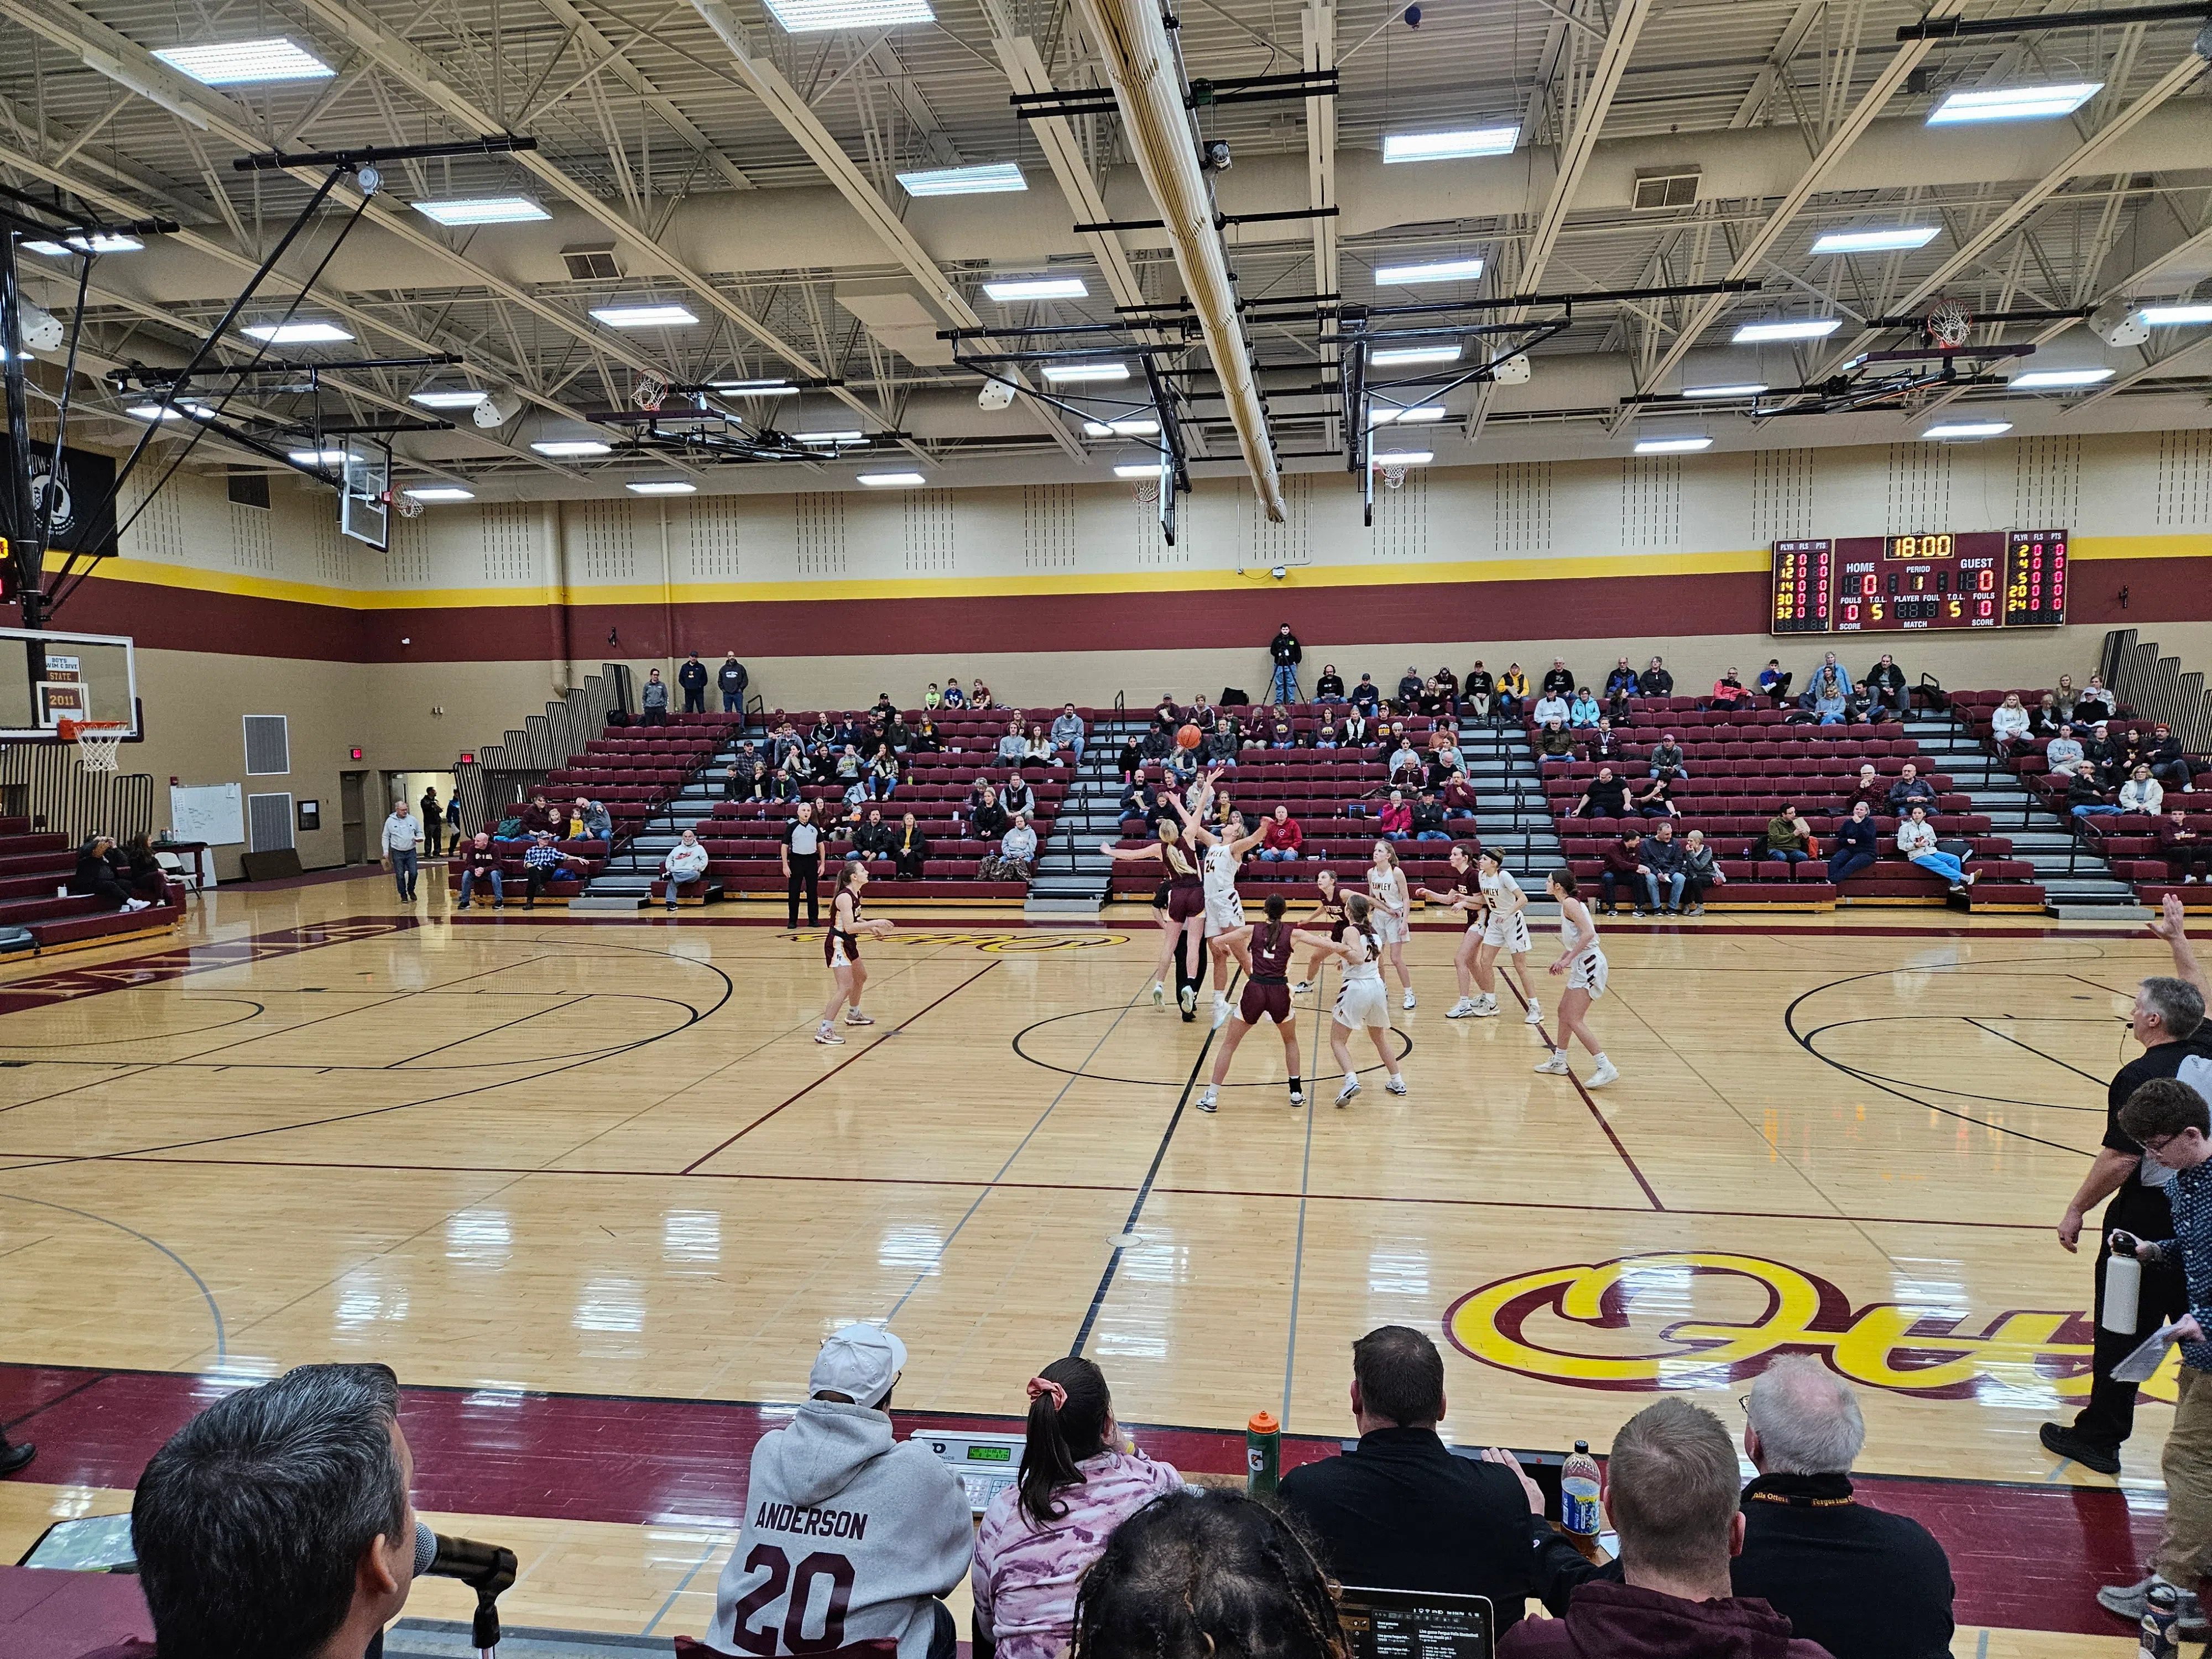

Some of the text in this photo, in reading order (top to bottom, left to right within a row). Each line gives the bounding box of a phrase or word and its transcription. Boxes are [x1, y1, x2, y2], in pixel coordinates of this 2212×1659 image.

[1895, 535, 1951, 557] 18:00
[2019, 544, 2064, 557] 2 0 0
[1786, 553, 1828, 566] 2 0 0
[1960, 558, 1993, 568] GUEST
[2019, 556, 2064, 569] 4 0 0
[1780, 566, 1828, 579] 12 0 0
[1846, 562, 1875, 573] HOME
[1917, 576, 1923, 590] 1
[1979, 570, 1994, 591] 0
[2018, 571, 2063, 584] 5 0 0
[1780, 580, 1827, 592] 14 0 0
[1864, 575, 1877, 594] 0
[2009, 584, 2063, 597] 20 0 0
[1777, 592, 1827, 605] 30 0 0
[2008, 598, 2062, 611] 24 0 0
[1777, 606, 1827, 619] 32 0 0
[1847, 605, 1859, 620] 0
[1871, 604, 1883, 620] 5
[1949, 601, 1961, 617] 5
[1980, 600, 1992, 616] 0
[50, 695, 74, 706] 2011
[1206, 859, 1215, 873] 24
[1488, 898, 1497, 908] 5
[754, 1501, 868, 1540] ANDERSON
[733, 1543, 855, 1657] 20
